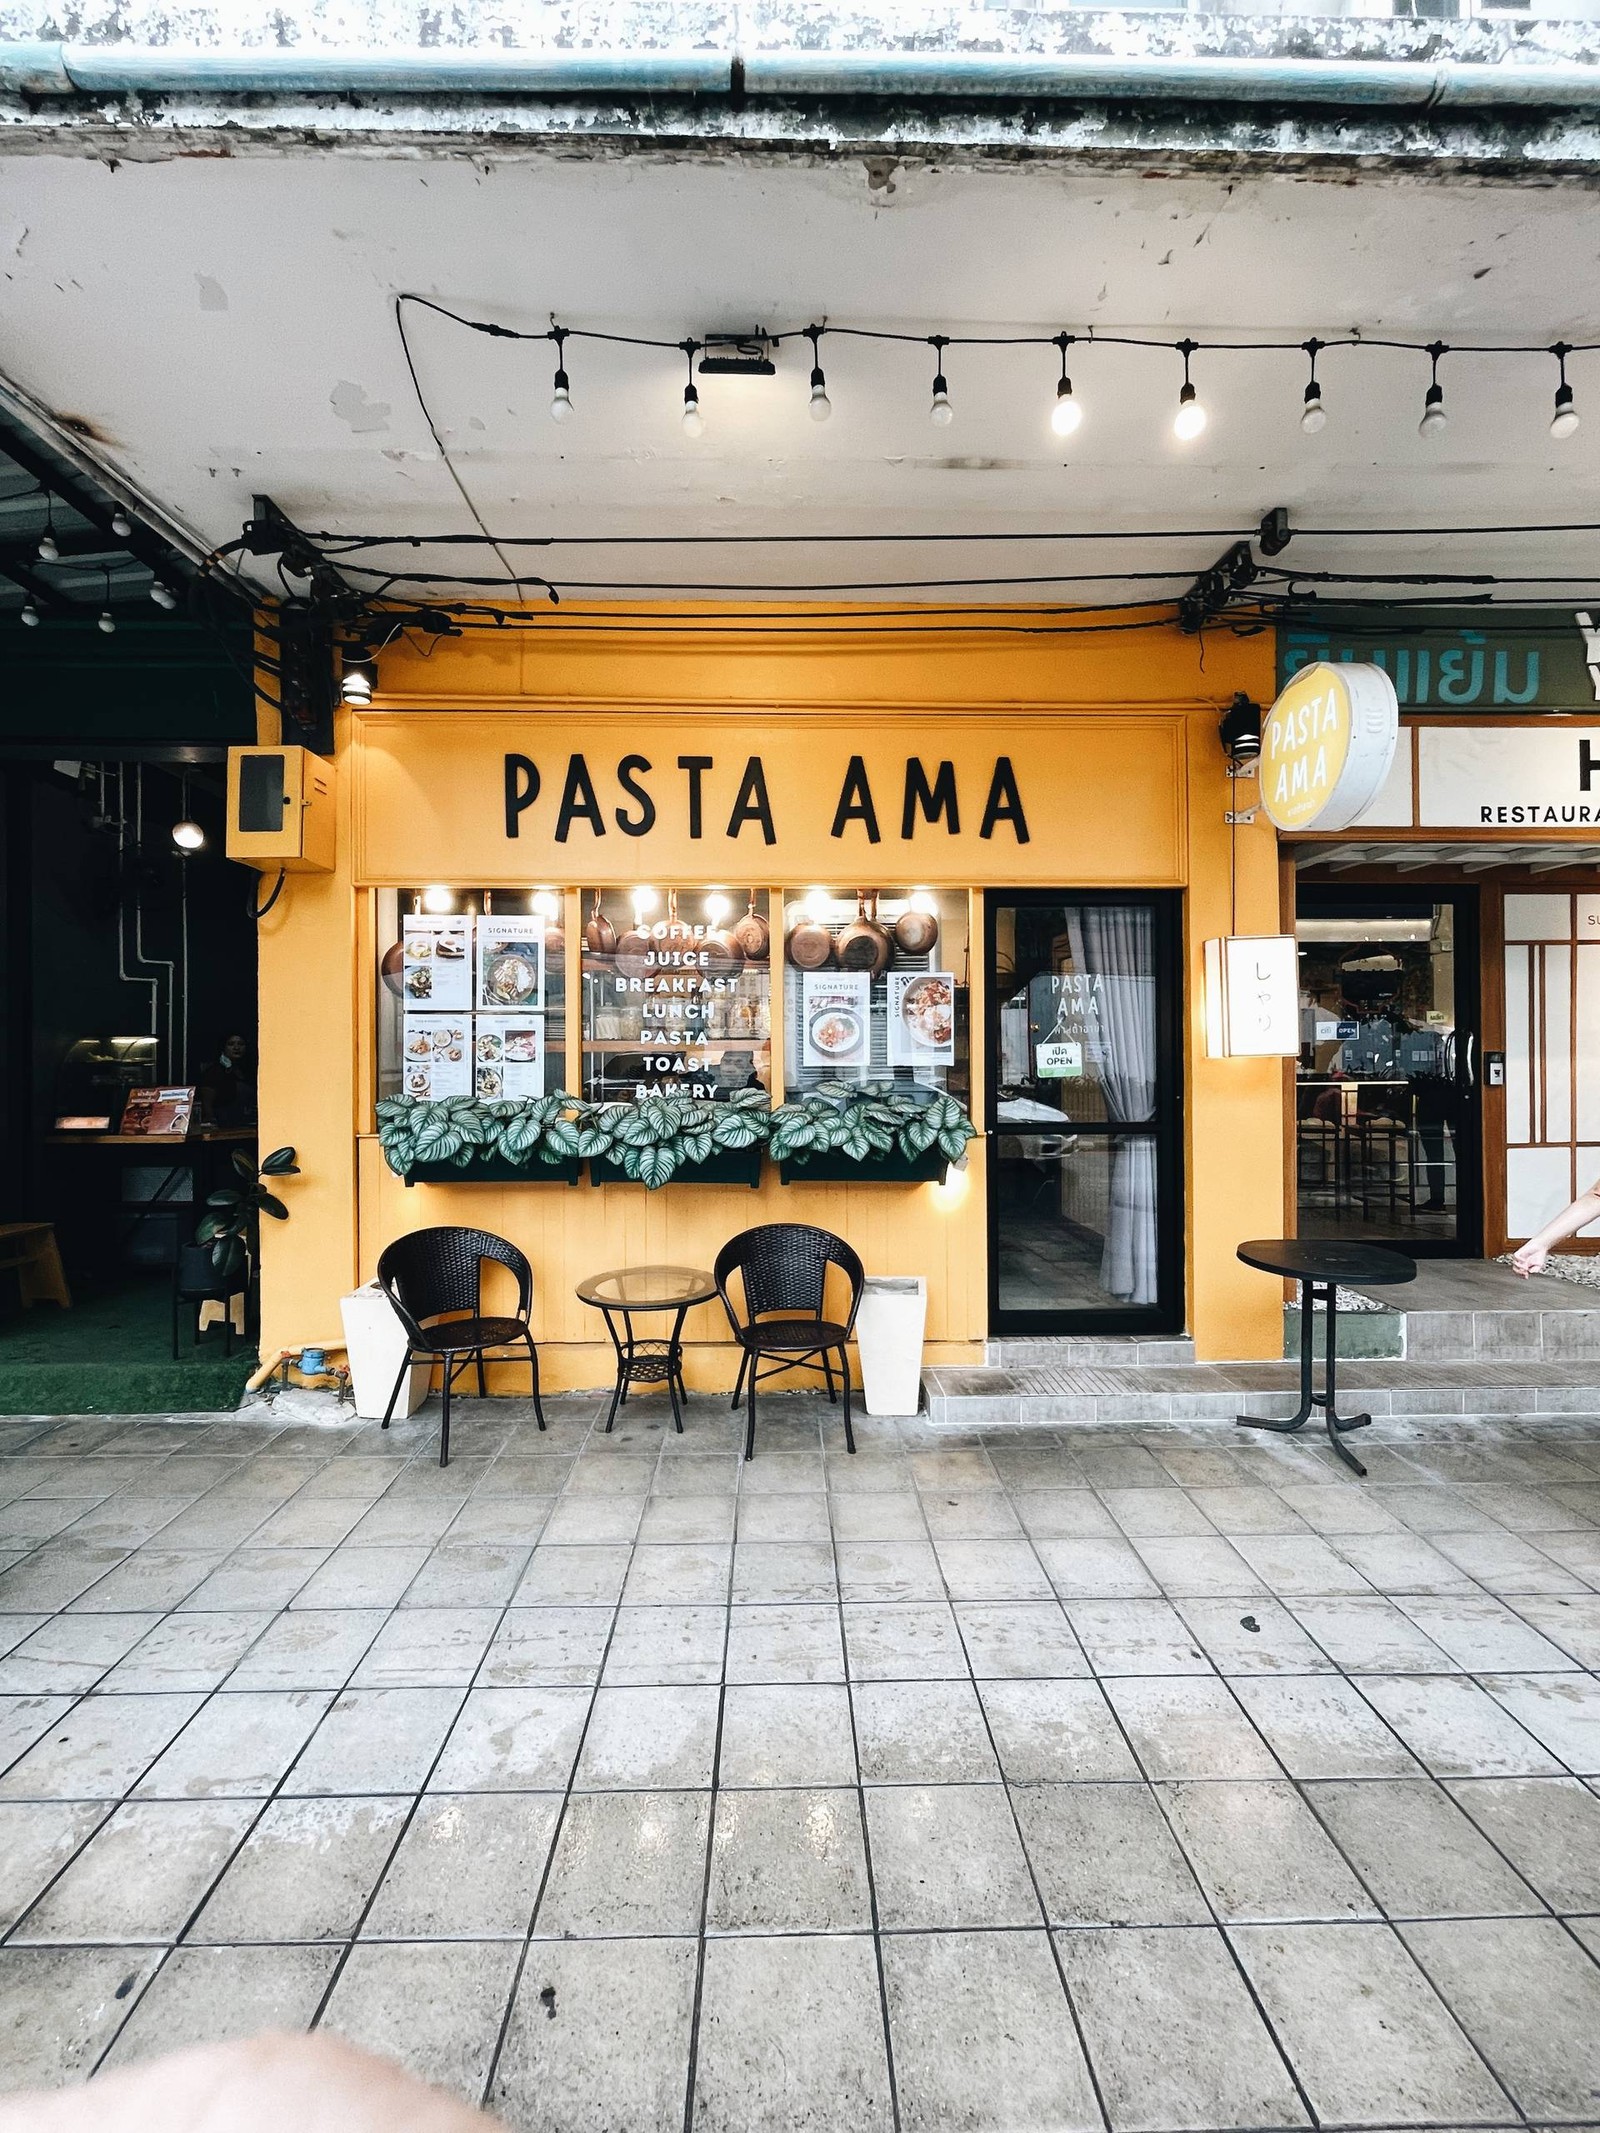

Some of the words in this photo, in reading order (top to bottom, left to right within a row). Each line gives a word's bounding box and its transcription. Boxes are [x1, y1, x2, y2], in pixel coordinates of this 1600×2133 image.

[1271, 688, 1338, 760] PASTA
[1274, 745, 1327, 803] AMA
[504, 753, 777, 846] PASTA
[830, 755, 1031, 844] AMA
[636, 924, 718, 940] COFFEE
[643, 951, 710, 966] JUICE
[615, 977, 739, 993] BREAKFAST
[814, 983, 859, 991] SIGNATURE
[1051, 974, 1105, 994] PASTA
[642, 1002, 715, 1019] LUNCH
[1057, 996, 1100, 1016] AMA
[640, 1030, 709, 1046] PASTA
[642, 1056, 712, 1072] TOAST
[1046, 1057, 1073, 1066] OPEN
